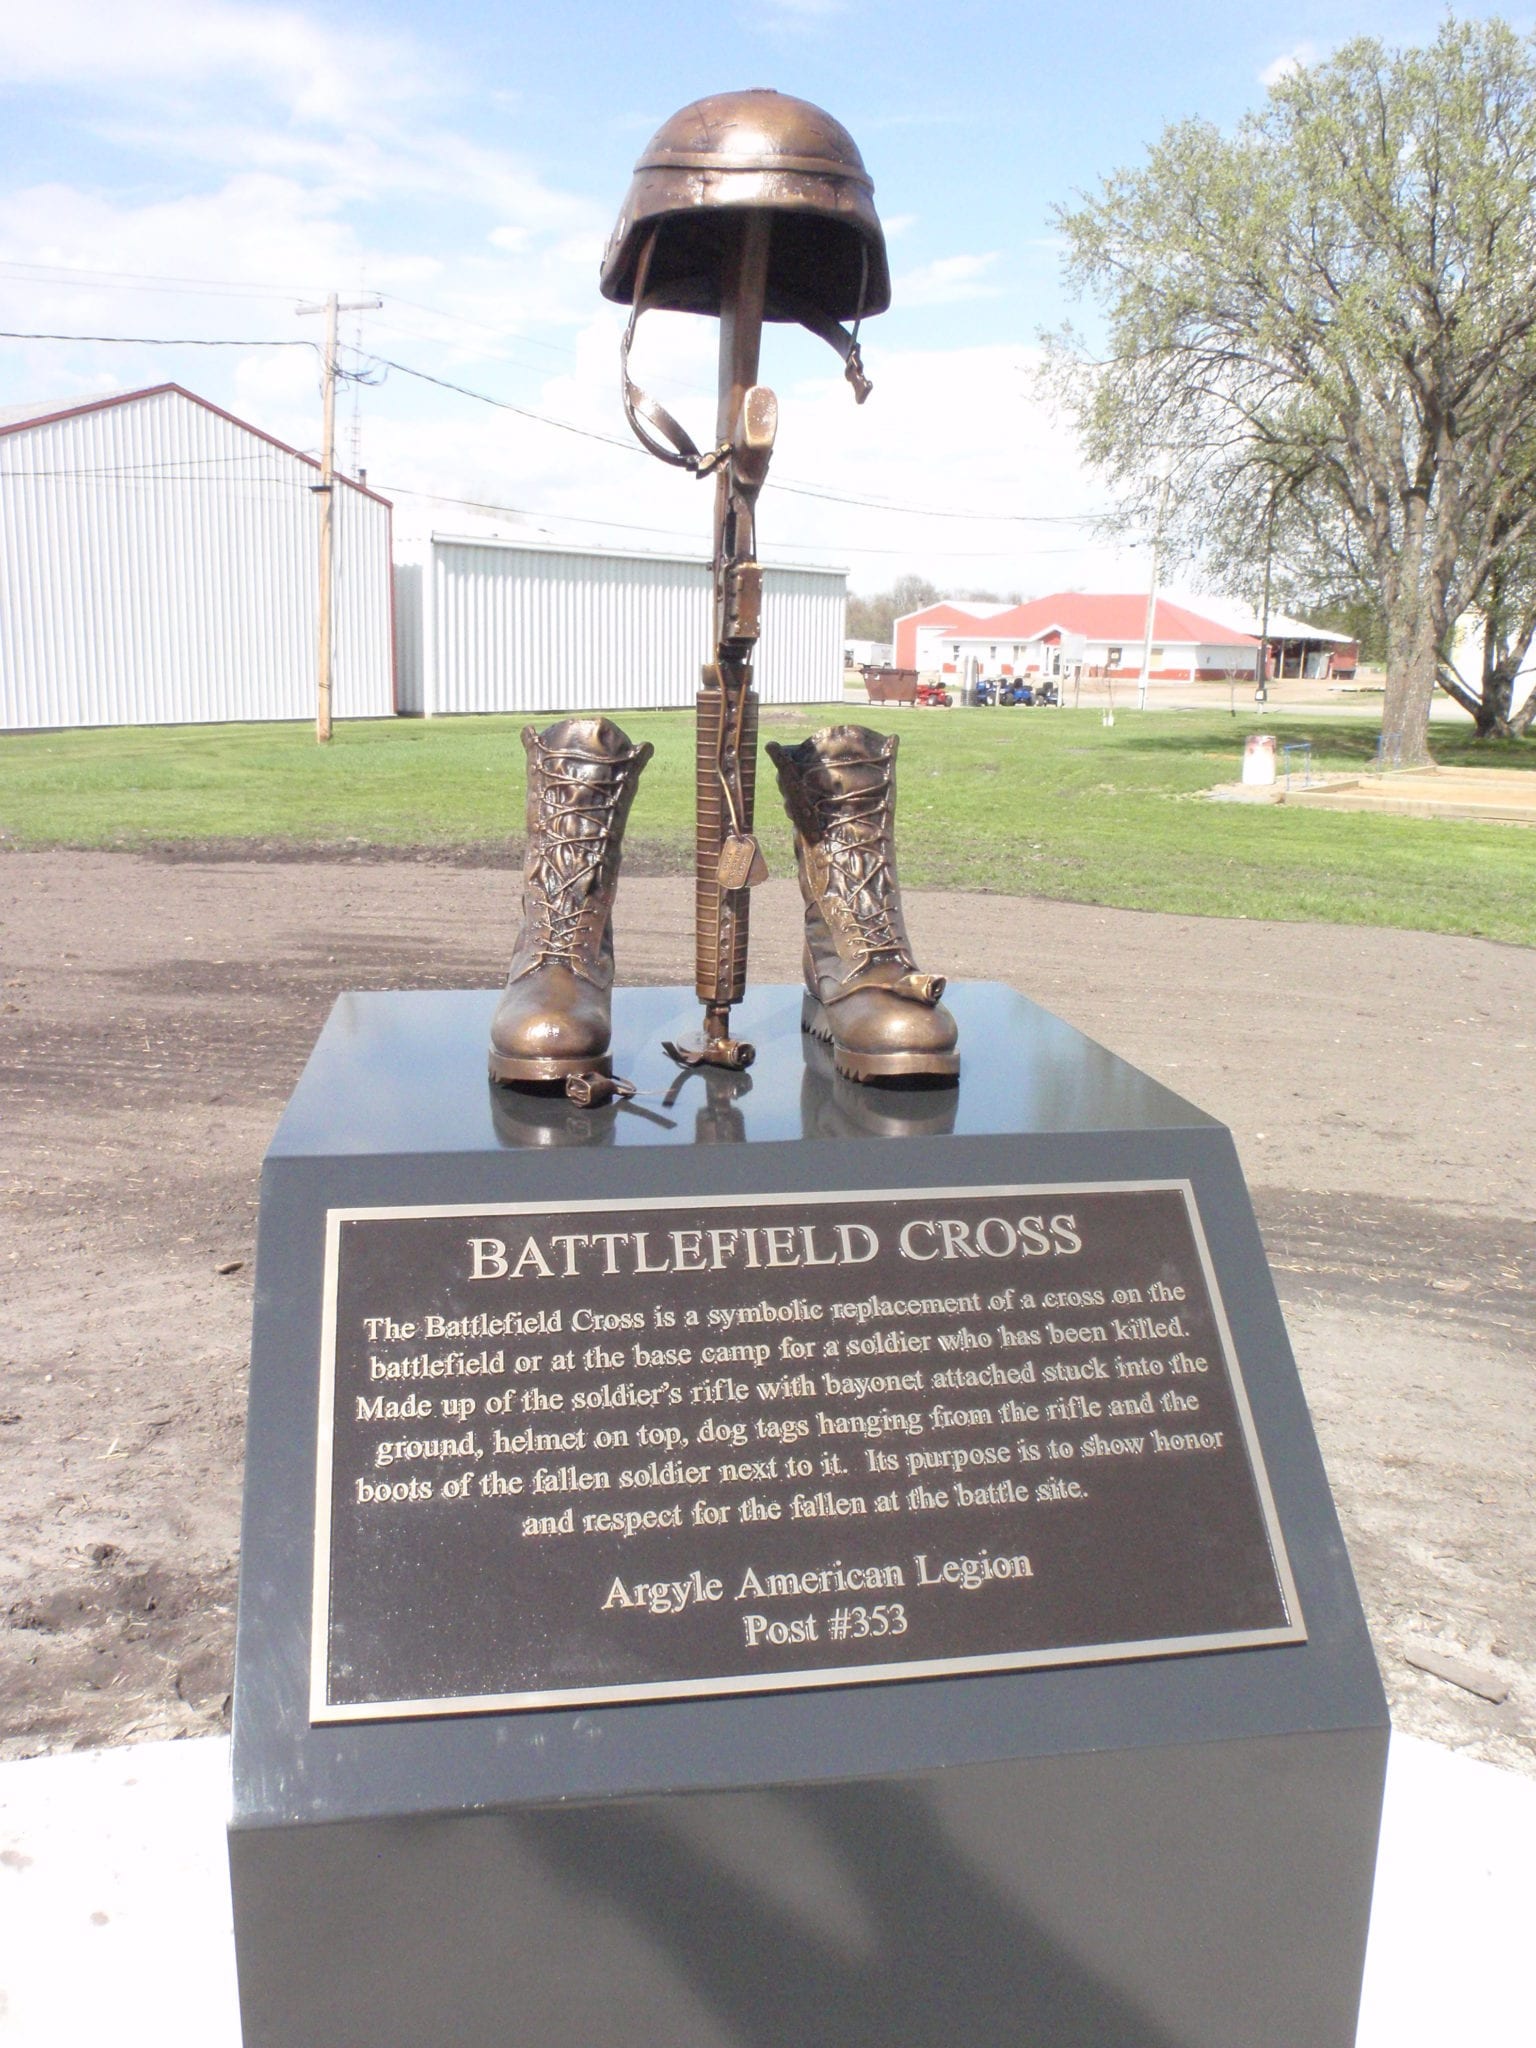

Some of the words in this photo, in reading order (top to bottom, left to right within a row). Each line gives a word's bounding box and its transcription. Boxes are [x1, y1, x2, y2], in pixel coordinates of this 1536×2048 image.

[467, 1224, 879, 1281] BATTLEFIELD
[899, 1215, 1082, 1260] CROSS
[363, 1317, 420, 1342] The
[424, 1310, 562, 1340] Battlefield
[571, 1309, 645, 1333] Cross
[654, 1305, 676, 1329] is
[683, 1310, 700, 1327] a
[706, 1298, 823, 1329] symbolic
[830, 1293, 982, 1322] replacement
[988, 1288, 1015, 1312] of
[1020, 1294, 1036, 1309] a
[1042, 1290, 1105, 1308] cross
[1112, 1289, 1143, 1303] on
[1147, 1281, 1185, 1302] the
[370, 1350, 504, 1381] battlefield
[514, 1356, 542, 1374] or
[550, 1350, 575, 1372] at
[583, 1345, 624, 1371] the
[632, 1343, 692, 1367] base
[700, 1344, 770, 1368] camp
[778, 1336, 816, 1360] for
[823, 1340, 839, 1358] a
[846, 1331, 931, 1357] soldier
[937, 1327, 992, 1351] who
[998, 1325, 1042, 1346] has
[1045, 1322, 1108, 1343] been
[1111, 1316, 1189, 1341] killed.
[355, 1394, 432, 1421] Made
[441, 1398, 475, 1423] up
[484, 1389, 516, 1415] of
[520, 1387, 563, 1413] the
[571, 1382, 682, 1411] soldier's
[690, 1378, 749, 1404] rifle
[756, 1374, 816, 1400] with
[822, 1370, 924, 1399] bayonet
[931, 1361, 1036, 1389] attached
[1042, 1357, 1110, 1383] stuck
[1114, 1356, 1164, 1378] into
[1168, 1352, 1208, 1374] the
[375, 1431, 483, 1468] ground,
[493, 1428, 586, 1455] helmet
[593, 1430, 629, 1449] on
[636, 1425, 688, 1453] top,
[697, 1418, 748, 1447] dog
[754, 1418, 809, 1443] tags
[815, 1408, 923, 1438] hanging
[929, 1405, 993, 1430] from
[998, 1400, 1040, 1424] the
[1045, 1396, 1102, 1421] rifle
[1108, 1392, 1155, 1416] and
[1159, 1390, 1199, 1412] the
[355, 1476, 434, 1504] boots
[440, 1472, 474, 1500] of
[479, 1470, 524, 1497] the
[532, 1465, 611, 1495] fallen
[619, 1460, 711, 1489] soldier
[718, 1457, 778, 1483] next
[785, 1457, 813, 1478] to
[820, 1454, 848, 1477] it.
[864, 1449, 899, 1472] Its
[905, 1447, 1011, 1475] purpose
[1017, 1439, 1041, 1462] is
[1046, 1440, 1074, 1459] to
[1080, 1433, 1144, 1458] show
[1150, 1429, 1223, 1453] honor
[521, 1508, 574, 1537] and
[582, 1504, 683, 1536] respect
[691, 1500, 731, 1526] for
[738, 1497, 781, 1523] the
[789, 1492, 867, 1520] fallen
[874, 1491, 900, 1512] at
[906, 1486, 949, 1510] the
[953, 1480, 1029, 1507] battle
[1035, 1476, 1088, 1502] site.
[601, 1570, 723, 1613] Argyle
[734, 1560, 905, 1600] American
[913, 1549, 1034, 1589] Legion
[742, 1614, 819, 1647] Post
[828, 1604, 907, 1640] #353
